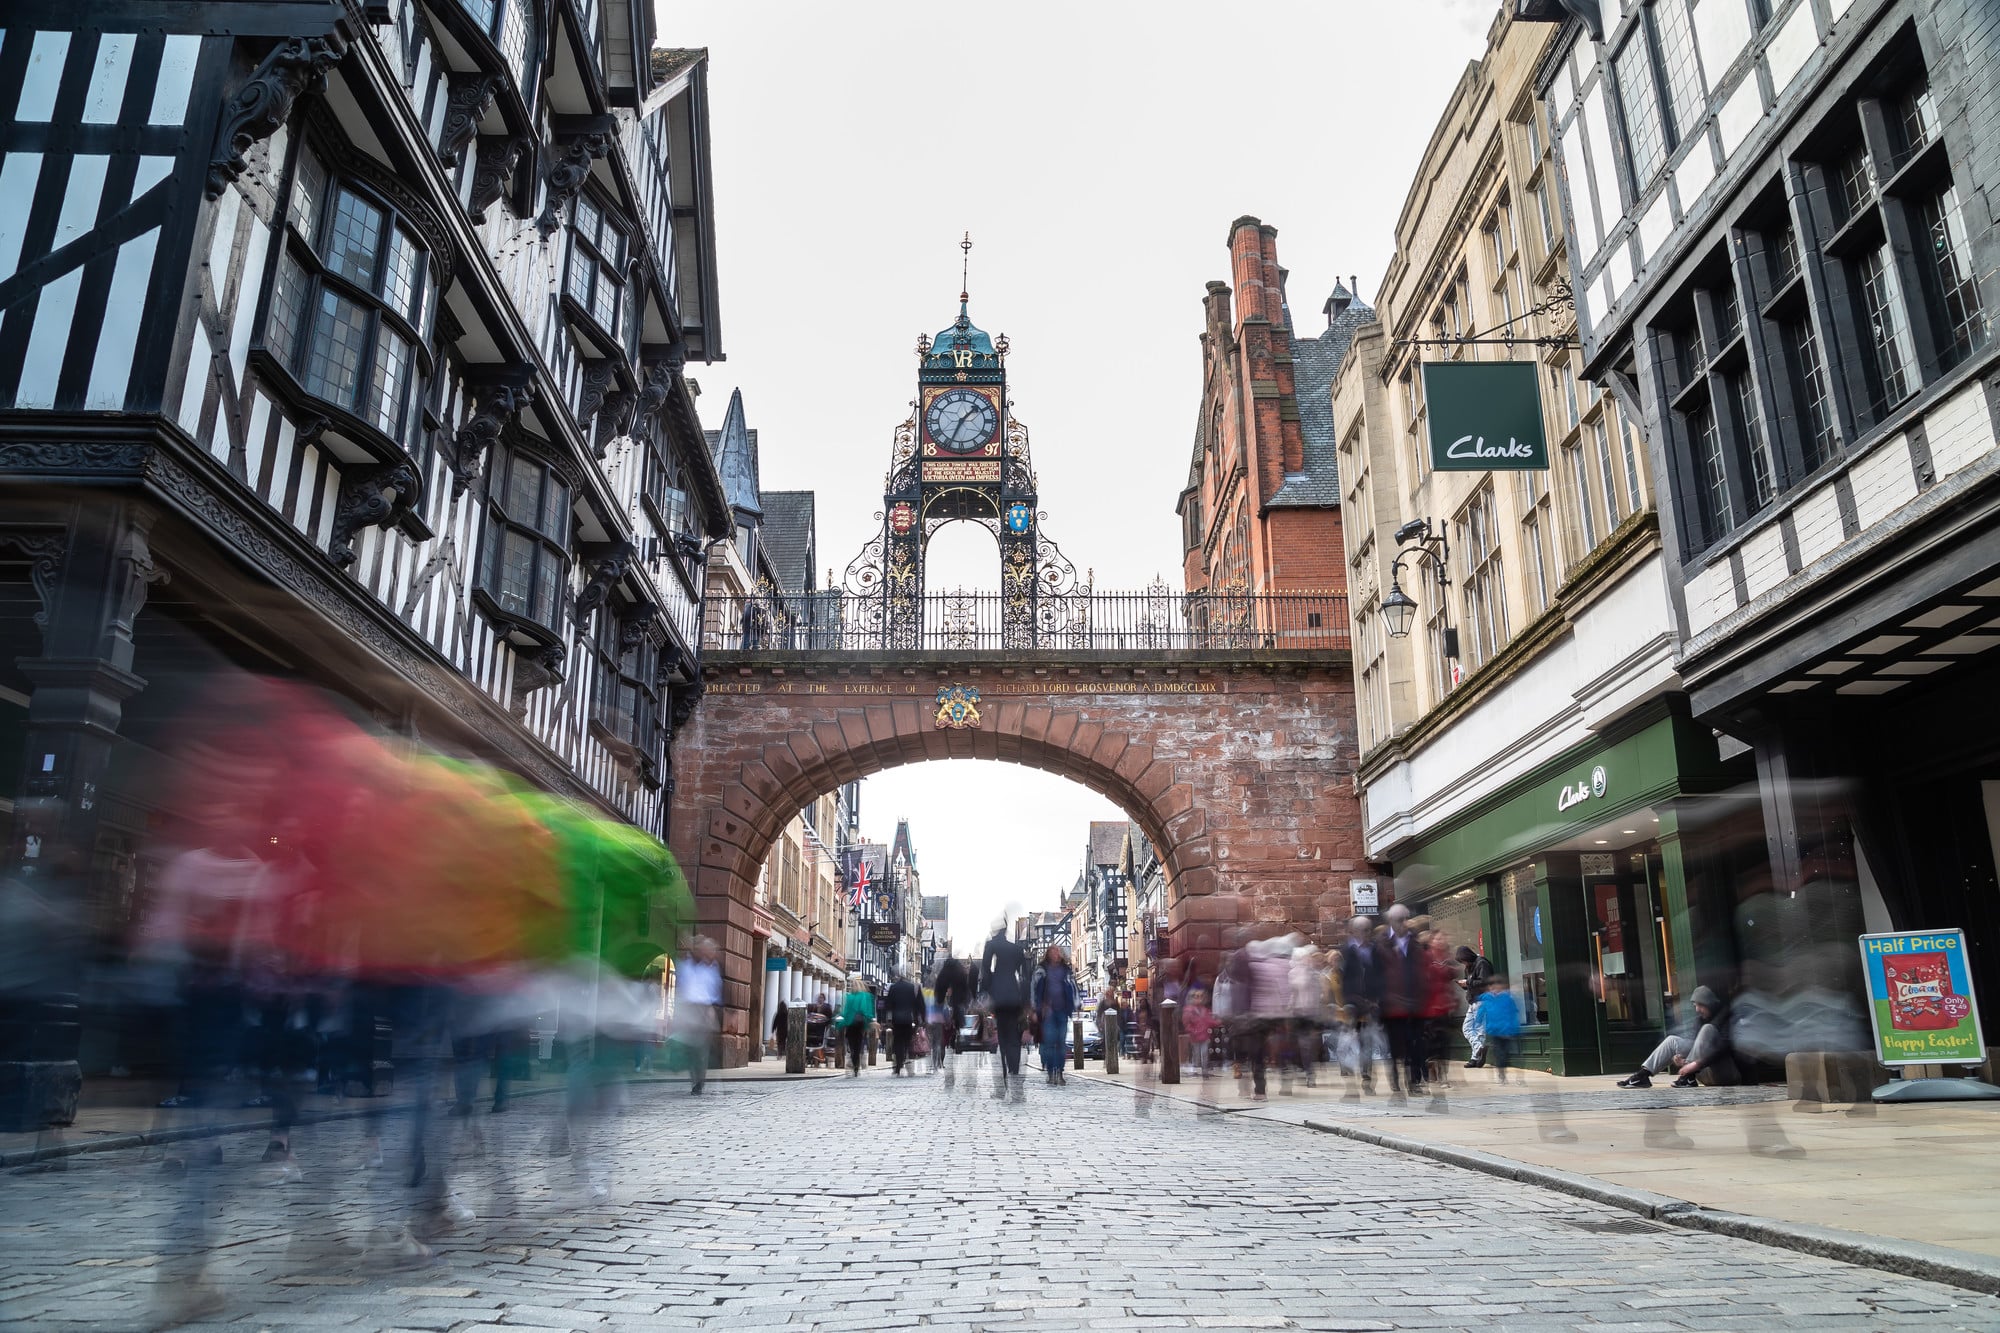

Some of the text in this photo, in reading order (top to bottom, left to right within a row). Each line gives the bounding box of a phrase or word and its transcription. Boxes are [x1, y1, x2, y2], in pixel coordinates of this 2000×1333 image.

[952, 350, 973, 368] VR
[923, 443, 938, 456] 18
[984, 442, 1000, 456] 97
[1446, 435, 1534, 459] Clarks
[705, 683, 917, 693] ERECTED AT THE EXPENCE OF
[995, 683, 1040, 693] RICHARD
[1043, 683, 1070, 693] LORD
[1075, 683, 1137, 693] GROSVENOR
[1558, 781, 1591, 812] Clarks
[1868, 936, 1957, 954] Half Price
[1944, 997, 1965, 1005] Only
[1883, 1033, 1974, 1051] Happy Easter!
